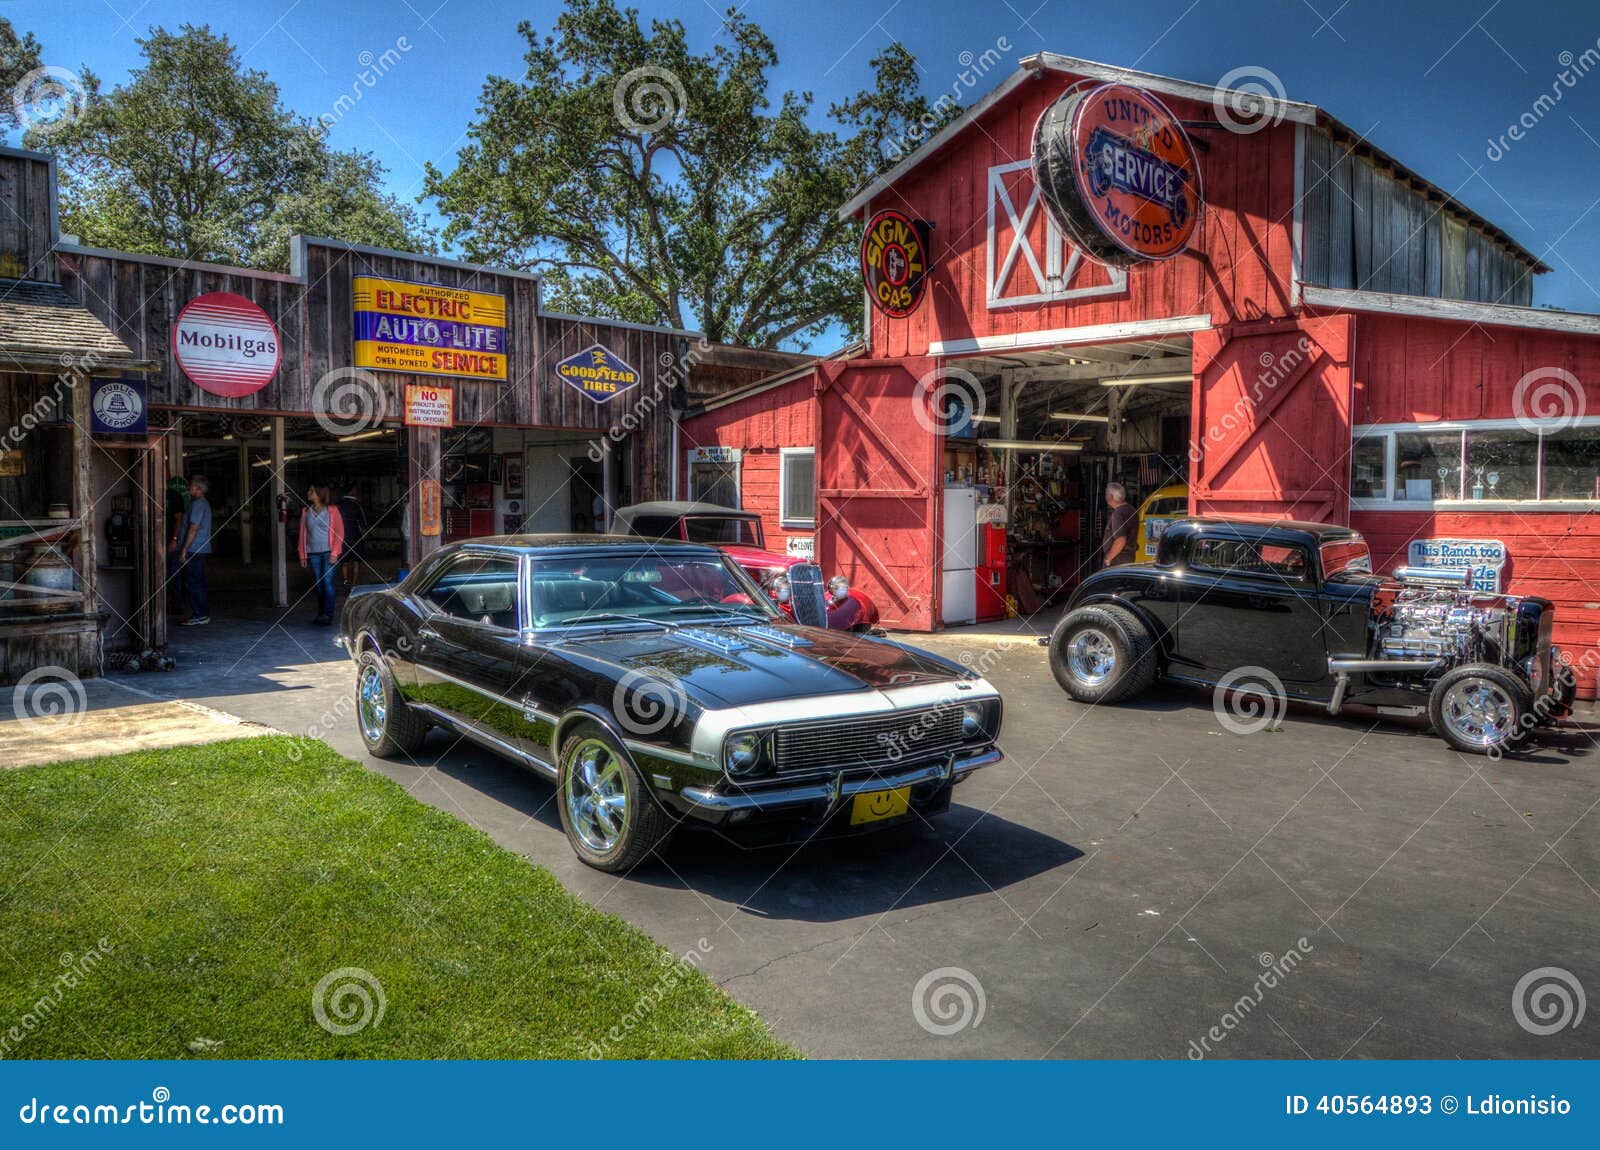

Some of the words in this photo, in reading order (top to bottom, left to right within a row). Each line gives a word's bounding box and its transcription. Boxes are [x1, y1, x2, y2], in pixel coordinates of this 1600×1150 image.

[1102, 143, 1175, 201] SERVICE
[1105, 199, 1173, 244] MOTORS
[867, 220, 922, 279] SIGNAL
[419, 287, 470, 300] AUTHORIZED
[878, 281, 912, 308] GAS
[376, 289, 471, 320] ELECTRIC
[375, 316, 497, 350] AUTO-LITE
[180, 330, 276, 358] Mobilgas
[377, 345, 425, 357] MOTOMETER
[375, 357, 397, 366] OWEN
[399, 358, 428, 368] DYNETO
[431, 350, 498, 375] SERVICE
[561, 364, 634, 383] GOODYEAR
[101, 384, 135, 396] PUBLIC
[582, 380, 616, 393] TIRES
[421, 391, 437, 401] NO
[97, 408, 138, 427] TELEPHONE
[1413, 543, 1439, 556] This
[1440, 544, 1477, 557] Ranch
[1479, 546, 1501, 558] too
[1441, 558, 1471, 566] USES
[876, 731, 899, 742] SS
